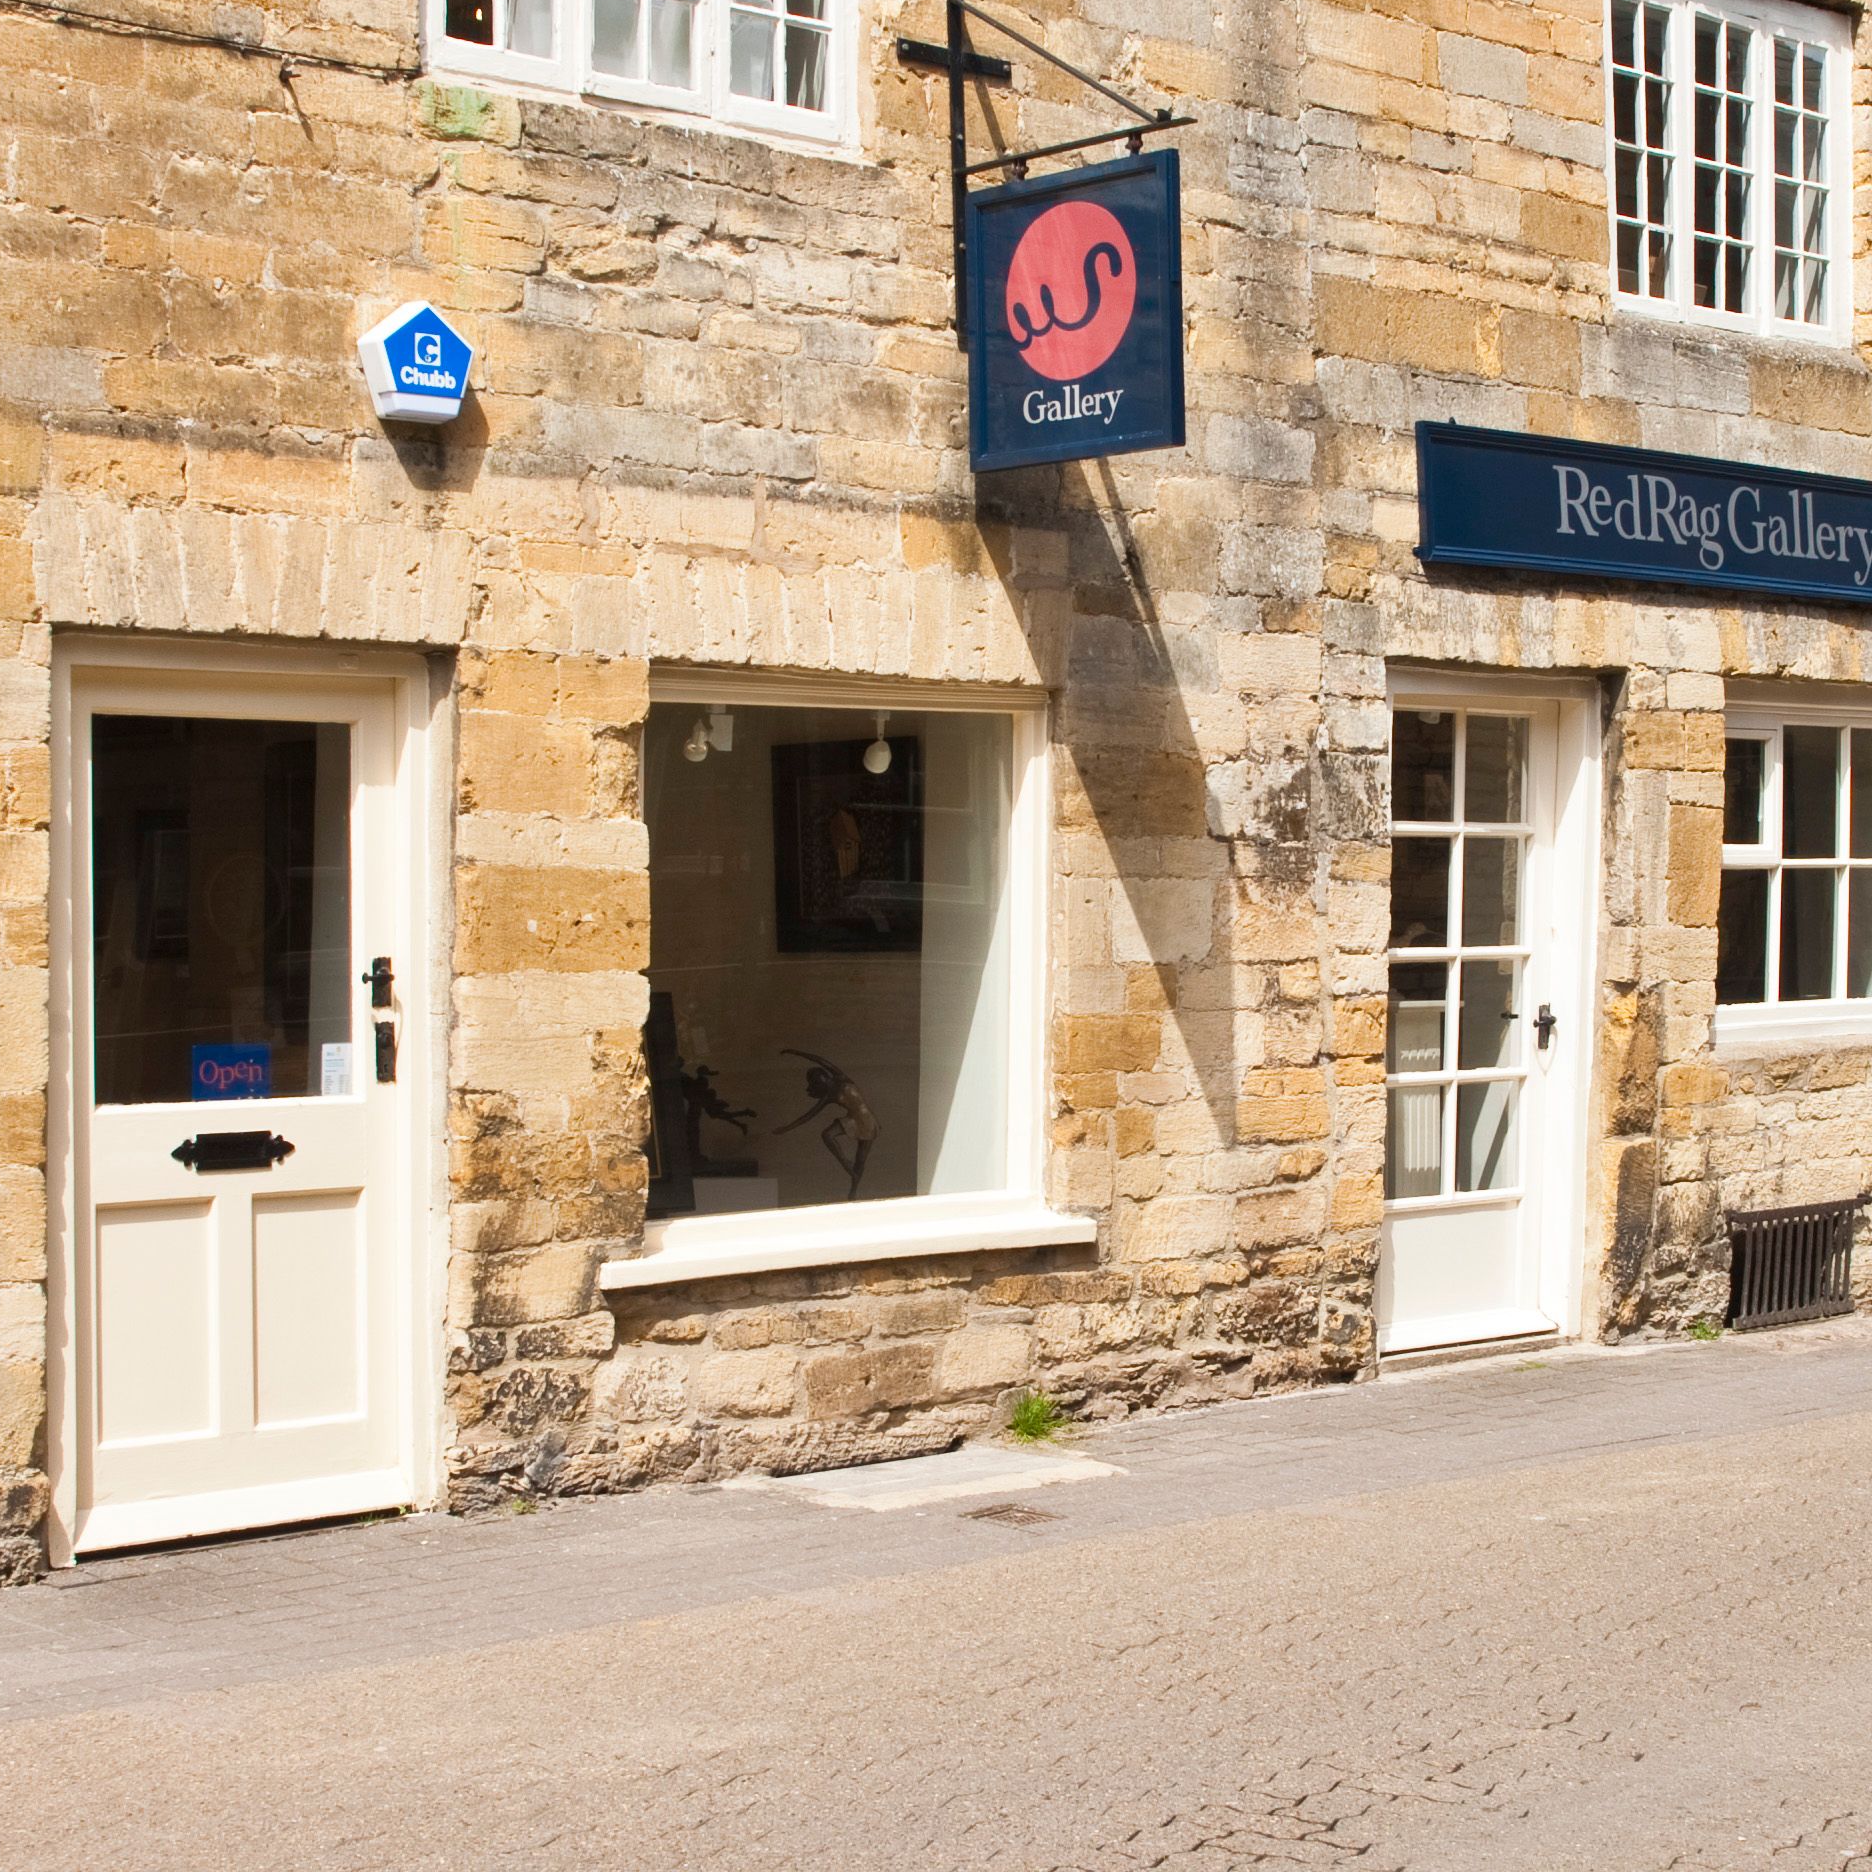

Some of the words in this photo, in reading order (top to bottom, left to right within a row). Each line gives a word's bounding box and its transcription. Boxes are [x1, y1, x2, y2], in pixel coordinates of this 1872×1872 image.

[399, 365, 457, 390] Chubb
[1022, 384, 1124, 425] Gallery
[199, 1059, 263, 1090] Open
